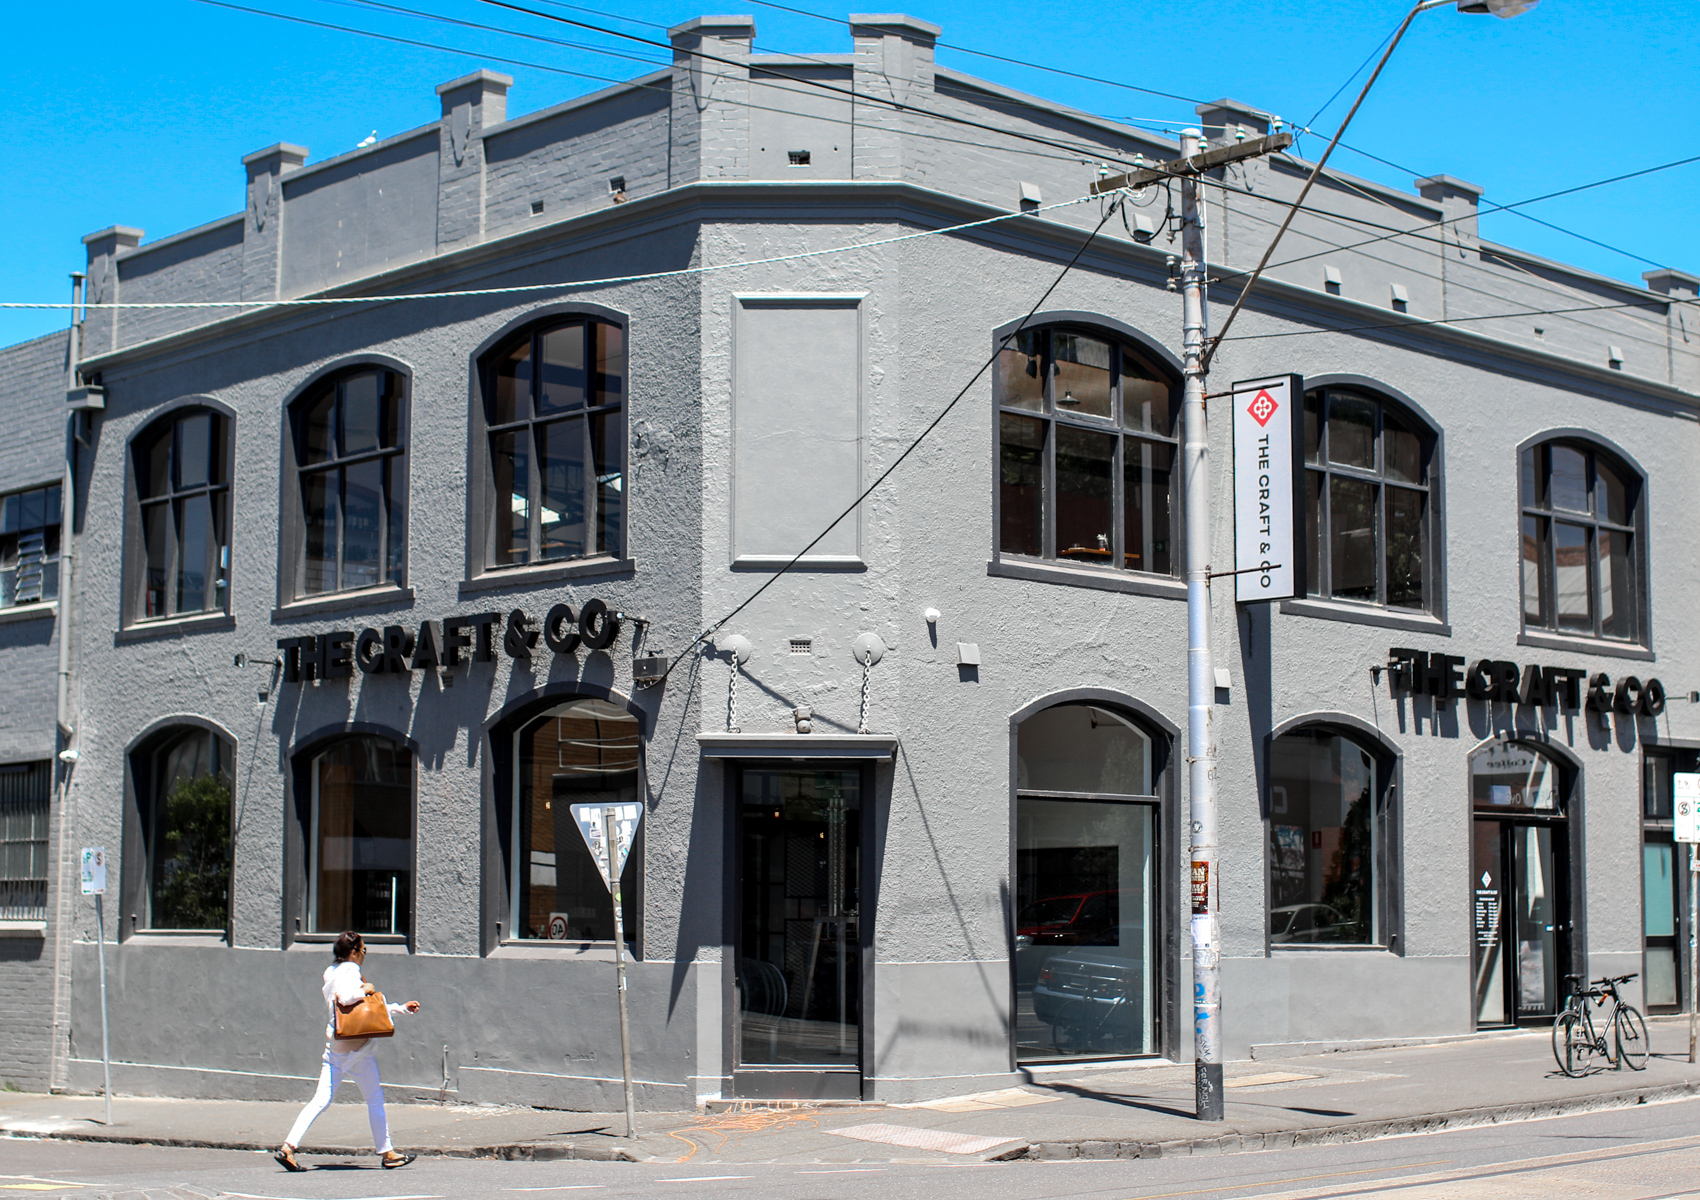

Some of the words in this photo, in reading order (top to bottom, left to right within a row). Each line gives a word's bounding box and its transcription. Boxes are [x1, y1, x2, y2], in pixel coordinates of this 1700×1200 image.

[1258, 434, 1270, 470] THE
[1258, 474, 1271, 536] CRAFT
[1259, 542, 1271, 555] &
[1260, 560, 1271, 588] CO
[277, 631, 354, 684] THE
[356, 612, 502, 674] CRAFT
[504, 609, 540, 659] &
[544, 598, 621, 654] CO
[1387, 647, 1465, 698] THE
[1466, 658, 1587, 709] CRAFT
[1586, 672, 1614, 712] &
[1613, 676, 1665, 717] CO
